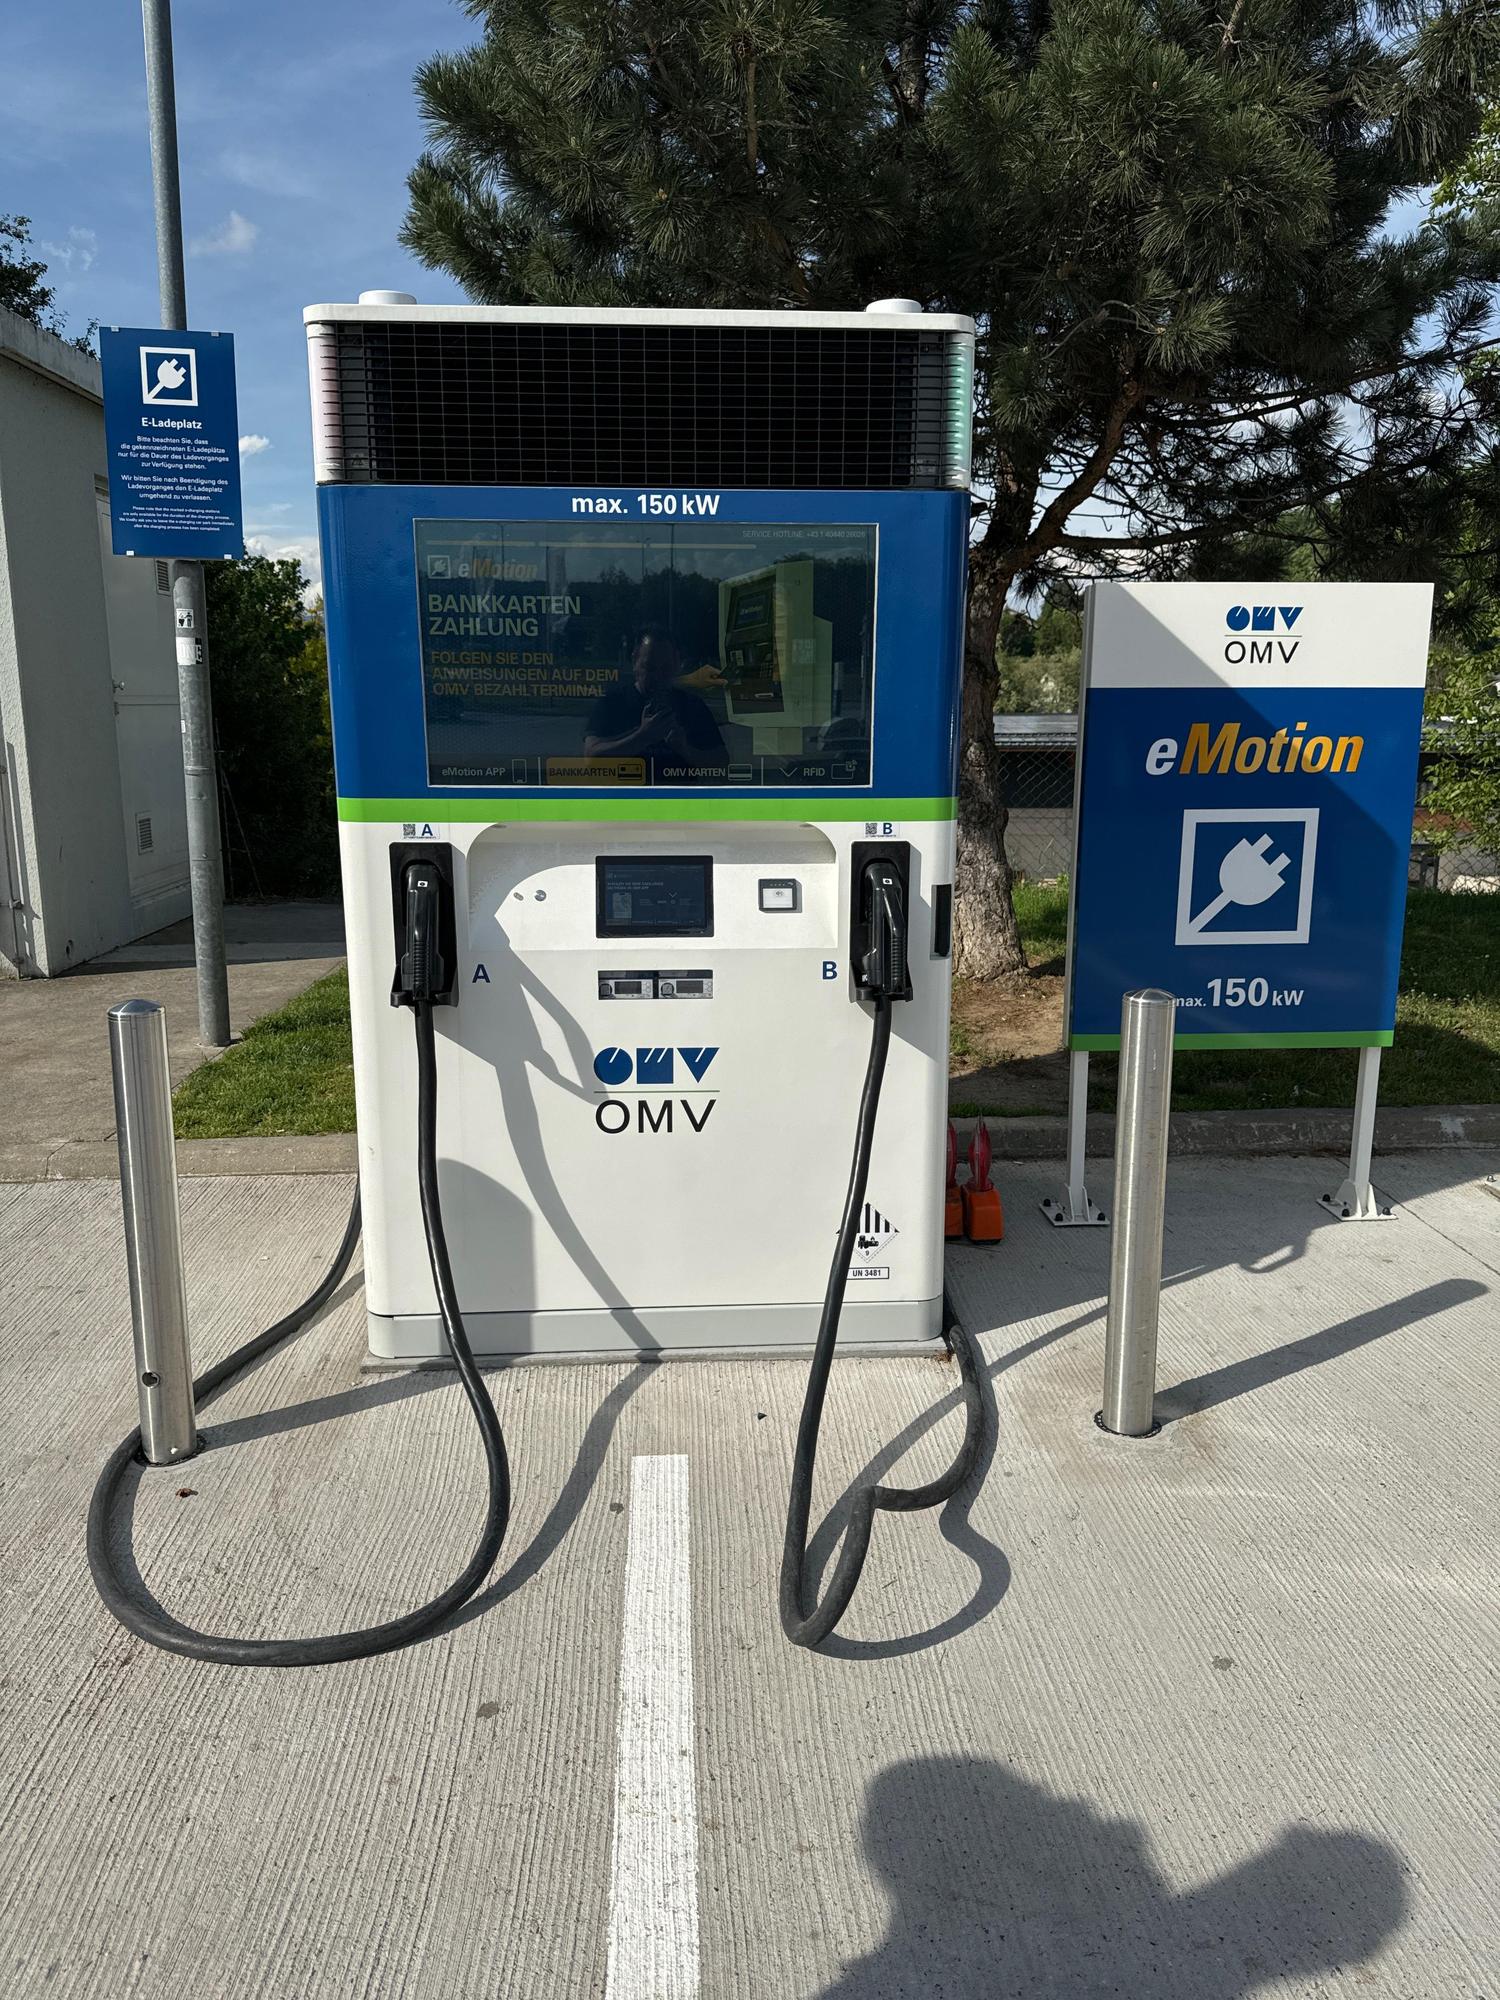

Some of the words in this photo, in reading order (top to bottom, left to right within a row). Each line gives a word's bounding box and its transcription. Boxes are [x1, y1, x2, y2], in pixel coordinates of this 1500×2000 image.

[142, 418, 202, 430] E-Ladeplatz
[128, 483, 174, 491] Ladevorganges
[180, 477, 215, 485] Beendigung
[572, 498, 628, 515] max.
[637, 494, 676, 515] 150
[682, 494, 721, 516] kW
[458, 558, 538, 580] eMotion
[428, 594, 580, 615] BANKKARTEN
[429, 617, 539, 636] ZAHLUNG
[432, 651, 492, 664] FOLGEN
[496, 652, 519, 665] SIE
[523, 653, 553, 665] DEN
[1224, 640, 1300, 664] OMV
[432, 667, 547, 681] ANWEISUNGEN
[552, 669, 582, 681] AUF
[585, 669, 618, 682] DEM
[433, 683, 470, 696] OMV
[474, 683, 606, 697] BEZAHLTERMINAL
[1145, 722, 1364, 776] eMotion
[441, 767, 483, 777] eMotion
[485, 767, 506, 777] APP
[549, 767, 616, 778] BANKKARTEN
[663, 767, 688, 777] OMV
[689, 767, 726, 777] KARTEN
[803, 767, 825, 777] RFID
[421, 824, 433, 836] A
[883, 823, 892, 834] B
[471, 964, 491, 984] A
[822, 960, 838, 980] B
[1207, 977, 1269, 1007] 150
[1272, 990, 1304, 1006] kW
[595, 1099, 717, 1134] OMV
